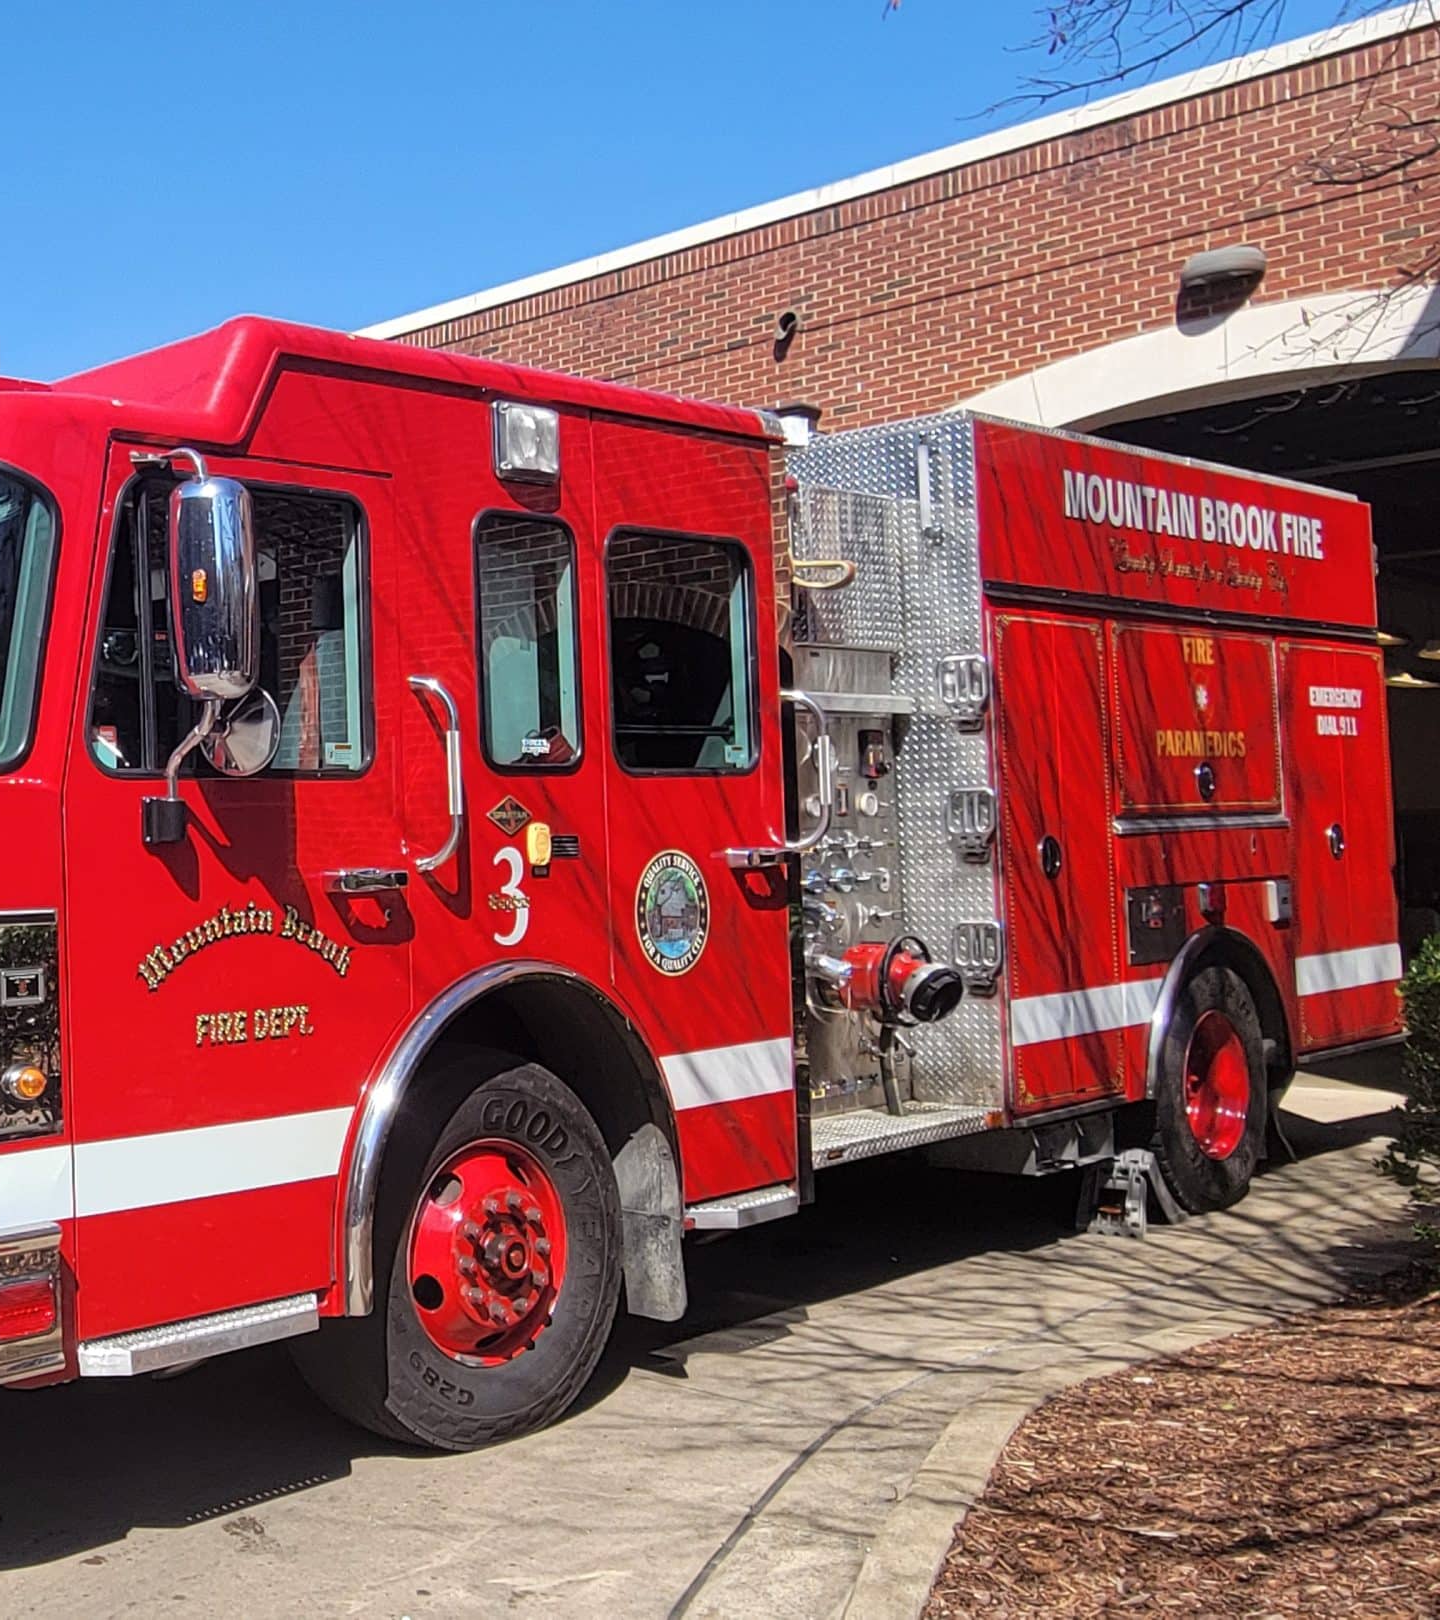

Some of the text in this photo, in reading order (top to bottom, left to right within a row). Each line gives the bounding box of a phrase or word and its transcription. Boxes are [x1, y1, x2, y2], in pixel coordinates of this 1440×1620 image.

[1063, 469, 1325, 561] MOUNTAIN BROOK FIRE
[1182, 636, 1215, 666] FIRE
[1317, 714, 1359, 737] DIAL 911
[1156, 729, 1247, 758] PARAMEDICS
[643, 855, 673, 888] QUALITY
[493, 846, 529, 946] 3
[136, 900, 354, 992] Mountain Brook
[691, 927, 705, 955] CITY
[195, 1002, 315, 1047] FIRE DEPT.
